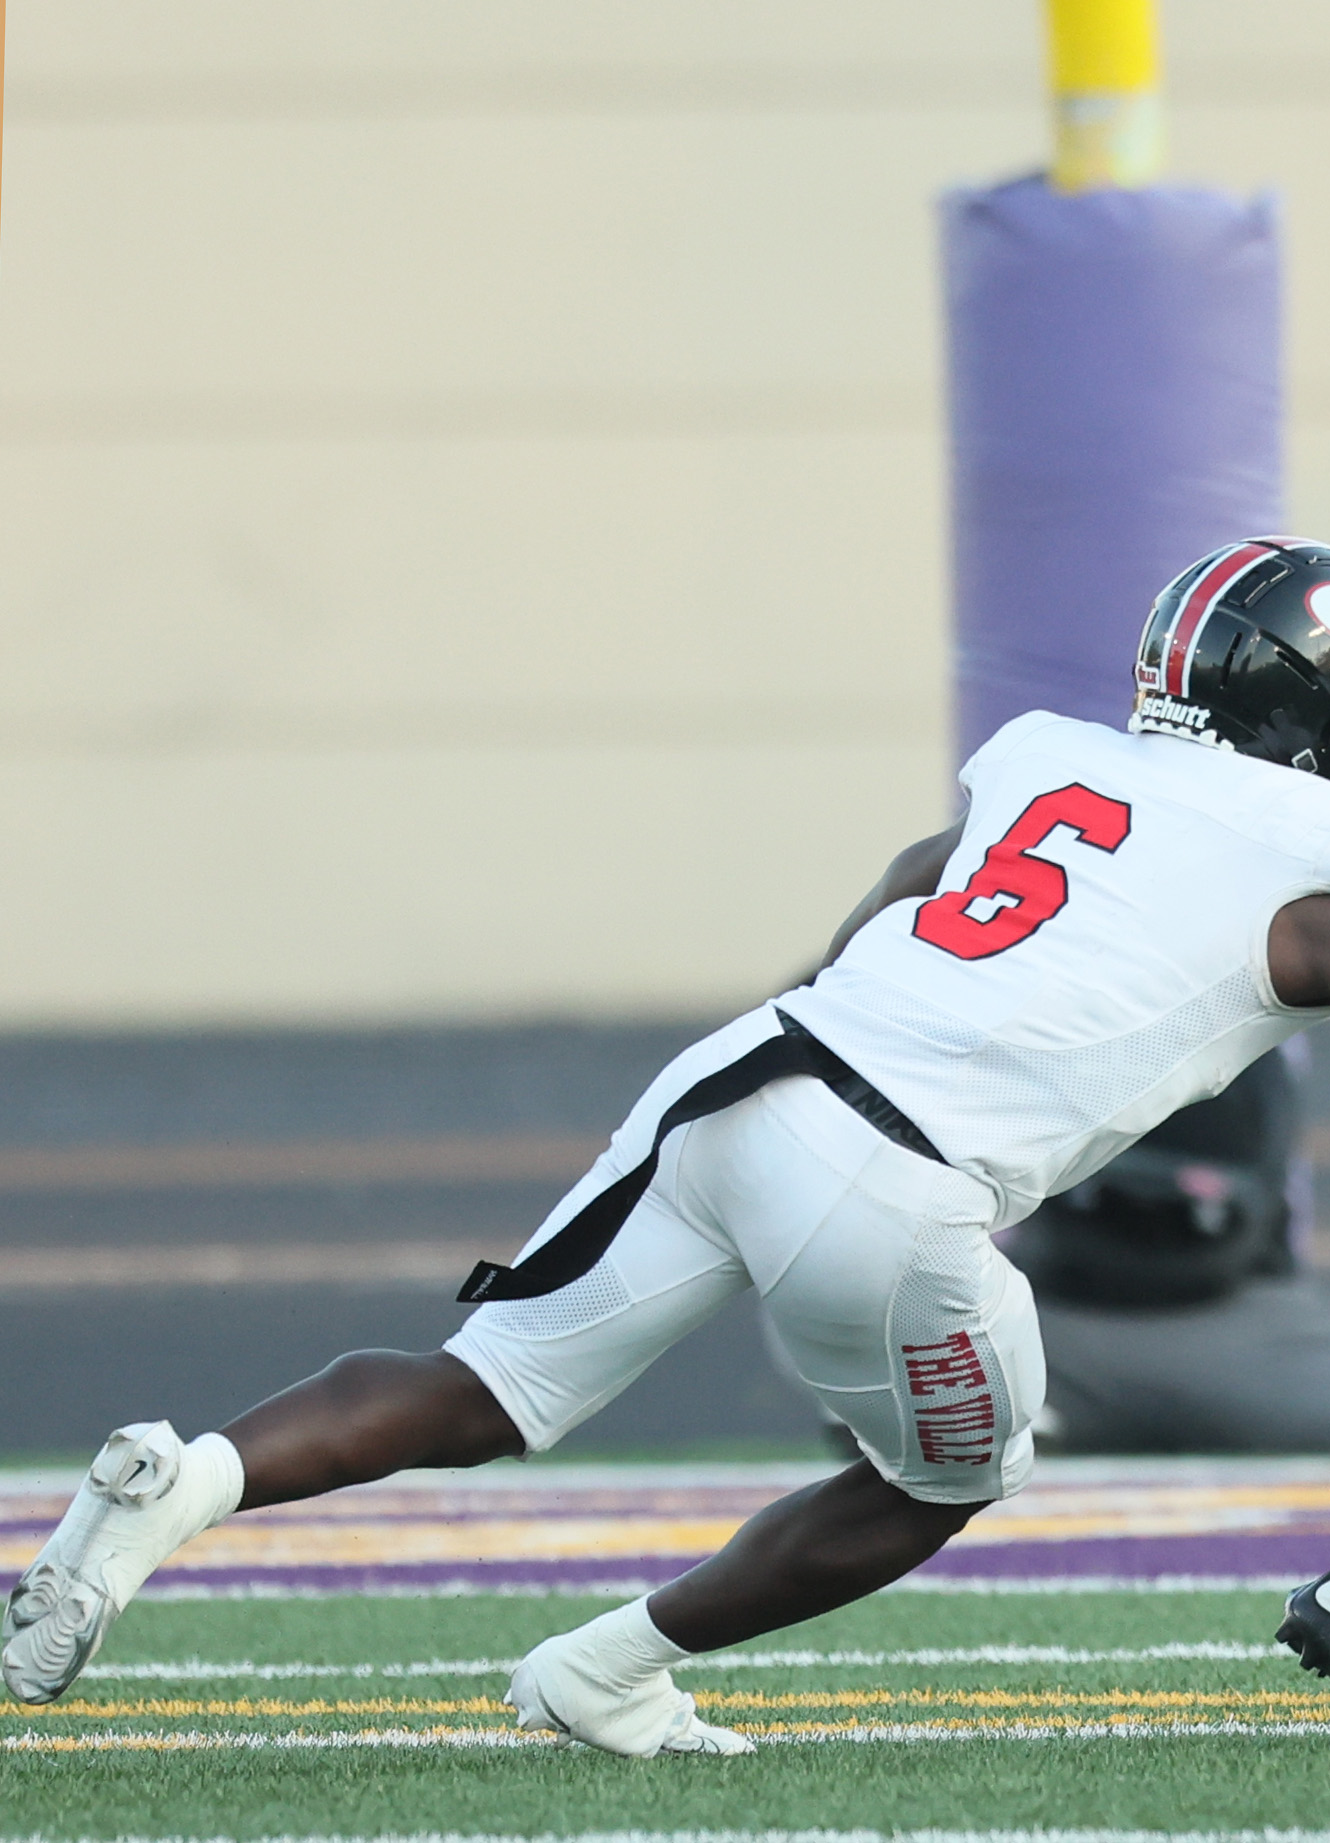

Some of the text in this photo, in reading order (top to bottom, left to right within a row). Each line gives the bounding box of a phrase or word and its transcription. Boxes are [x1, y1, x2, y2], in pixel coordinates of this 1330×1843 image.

[1142, 695, 1211, 729] schutt
[912, 782, 1131, 960] 6
[902, 1330, 994, 1465] THE VILLE
